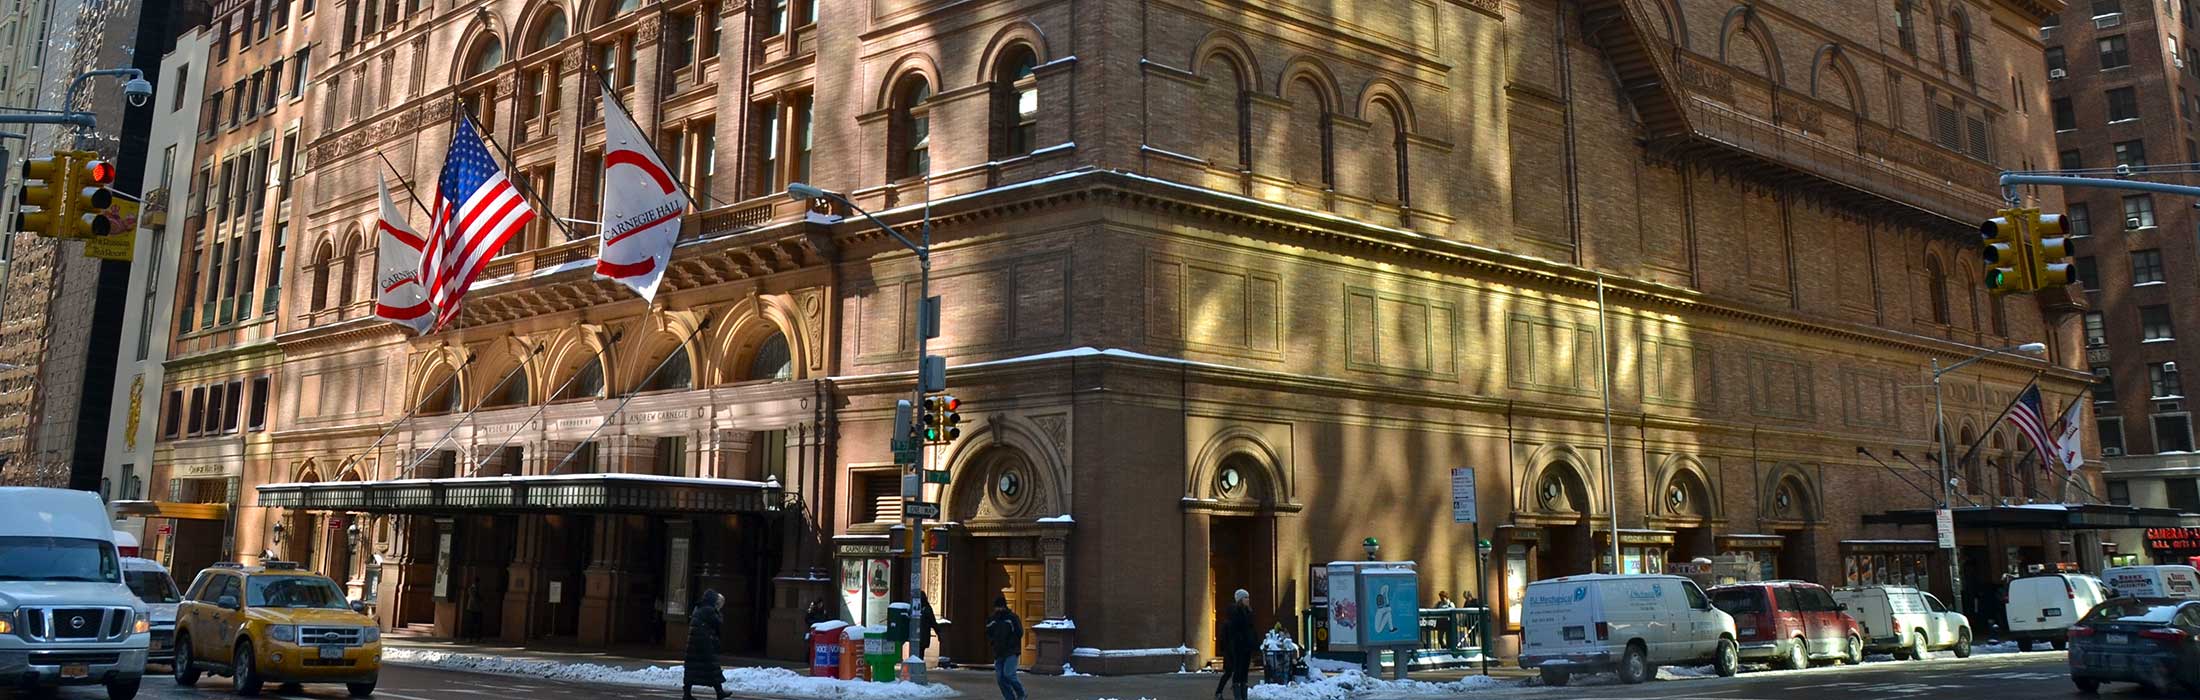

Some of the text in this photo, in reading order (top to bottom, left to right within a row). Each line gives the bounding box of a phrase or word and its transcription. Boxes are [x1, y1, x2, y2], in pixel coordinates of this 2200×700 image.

[603, 200, 682, 240] CARNEGIE HALL
[629, 412, 656, 423] ANDREW
[657, 409, 688, 421] CARNEGIE
[1418, 617, 1437, 628] ubway
